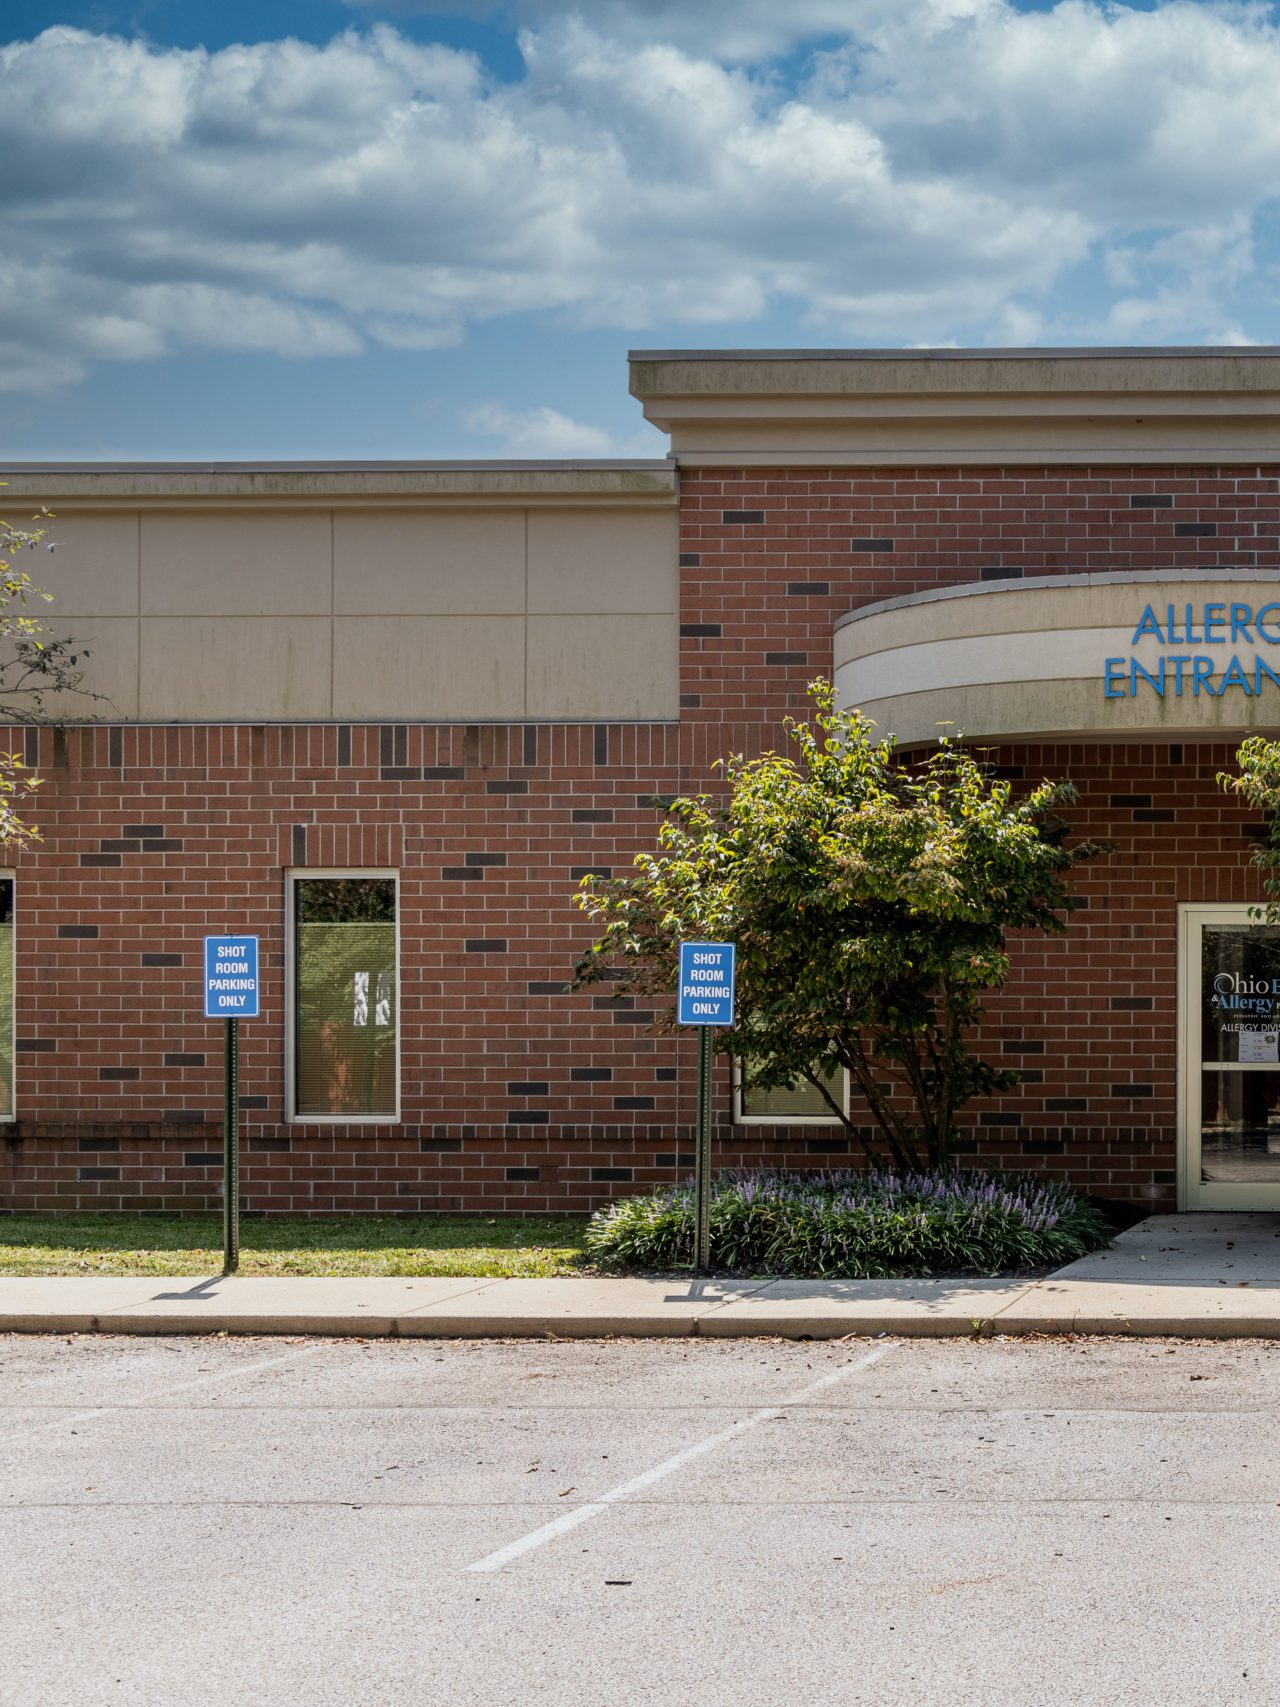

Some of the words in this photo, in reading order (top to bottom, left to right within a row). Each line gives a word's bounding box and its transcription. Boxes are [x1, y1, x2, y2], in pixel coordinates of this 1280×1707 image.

[217, 945, 247, 958] SHOT
[693, 952, 723, 965] SHOT
[215, 962, 249, 974] ROOM
[690, 969, 724, 981] ROOM
[208, 979, 256, 991] PARKING
[1213, 972, 1269, 994] Ohio
[683, 985, 730, 998] PARKING
[218, 995, 246, 1007] ONLY
[692, 1002, 720, 1014] ONLY
[1220, 1023, 1259, 1033] ALLERGY
